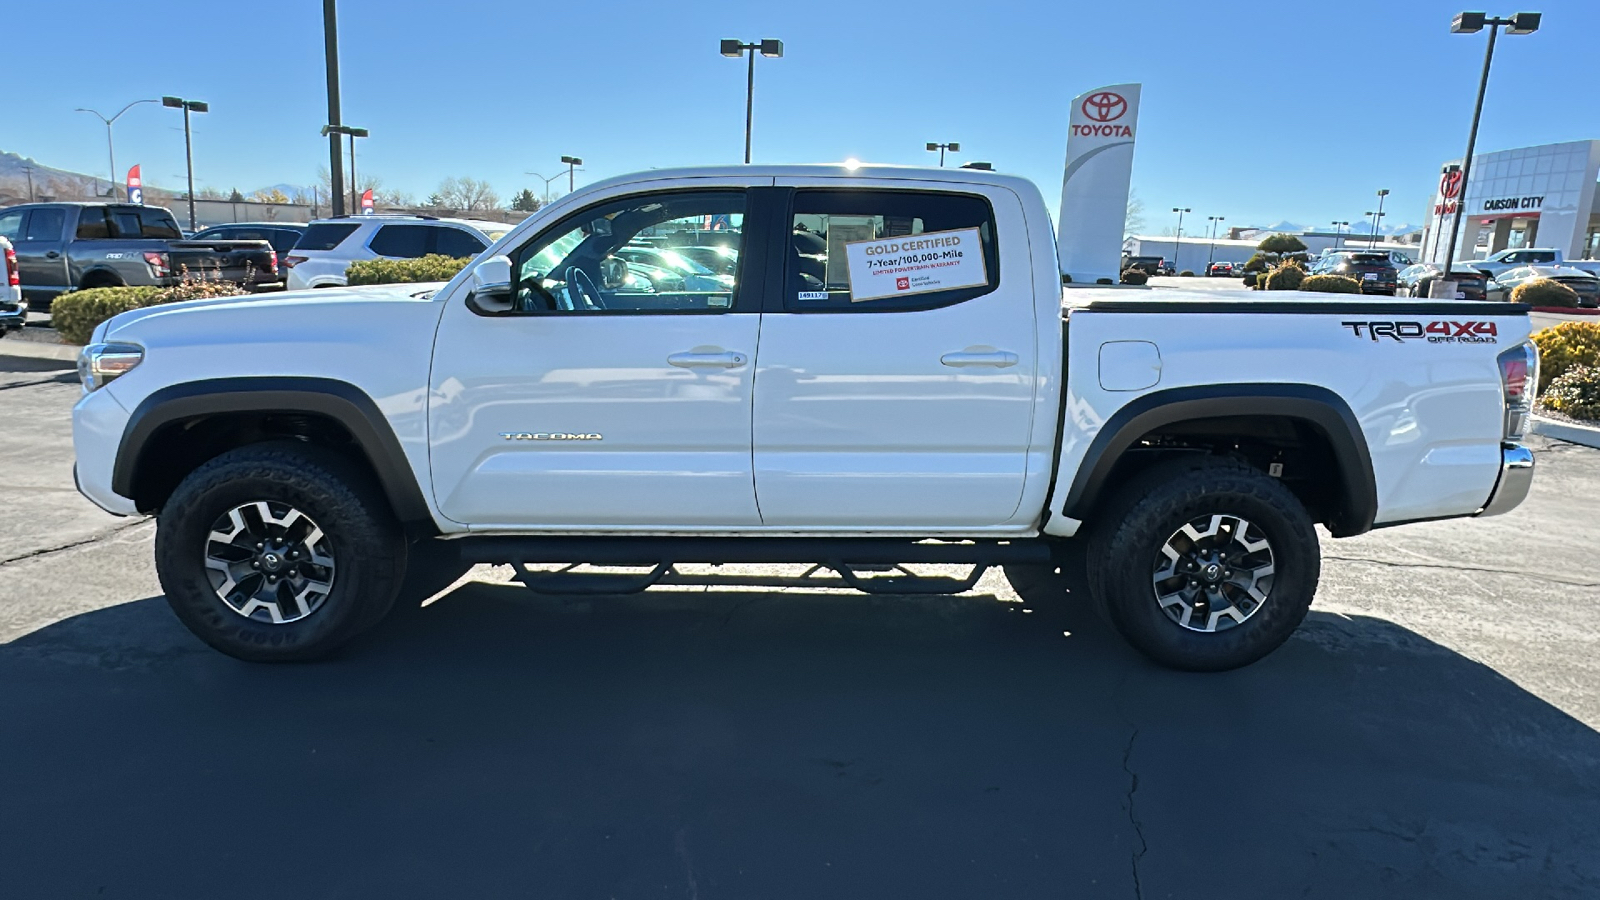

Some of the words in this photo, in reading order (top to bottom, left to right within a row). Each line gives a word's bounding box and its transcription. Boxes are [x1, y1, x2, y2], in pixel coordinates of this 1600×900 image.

[1072, 124, 1132, 137] TOYOTA
[1484, 197, 1519, 210] CARSON
[1521, 196, 1544, 208] CITY
[865, 243, 899, 256] GOLD
[901, 236, 961, 251] CERTIFIED
[866, 249, 963, 269] 7-Year/100,000-Mile
[872, 268, 894, 276] LIMITED
[894, 264, 930, 273] POWERTRAIN
[930, 260, 960, 269] WARRANTY
[1341, 321, 1426, 344] TRD
[1425, 321, 1498, 337] 4X4
[1427, 336, 1456, 344] OFF
[1457, 336, 1498, 344] ROAD
[498, 432, 603, 441] TACOMA
